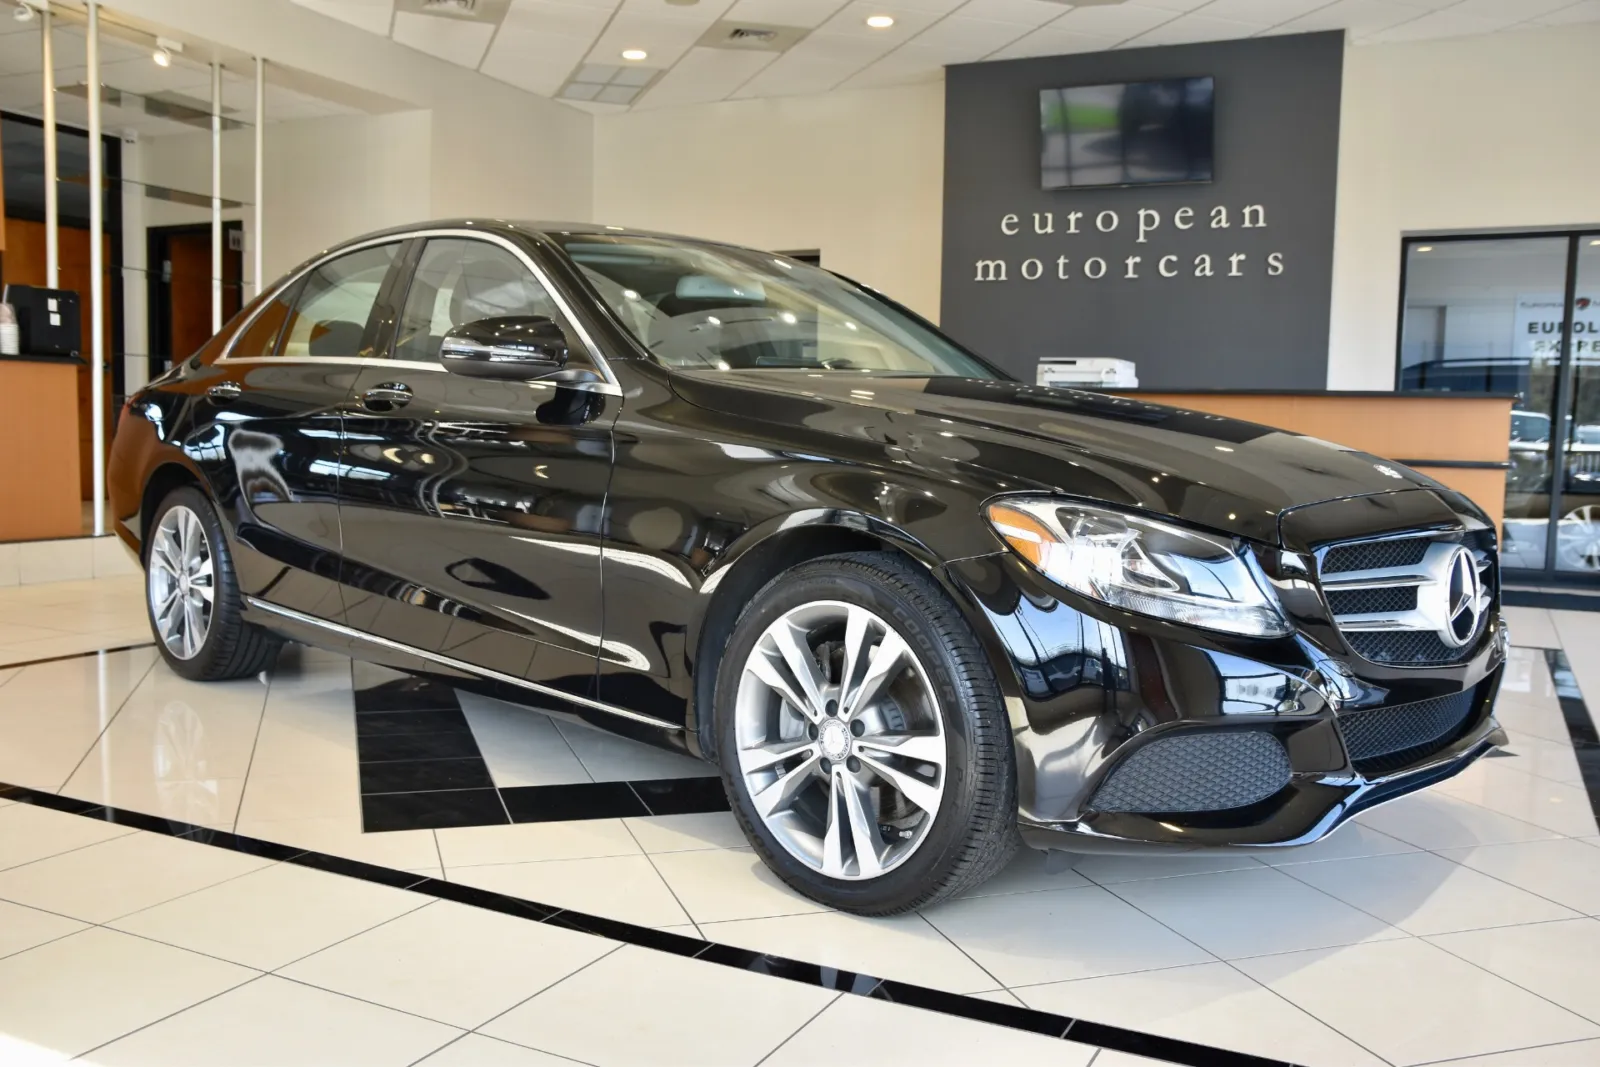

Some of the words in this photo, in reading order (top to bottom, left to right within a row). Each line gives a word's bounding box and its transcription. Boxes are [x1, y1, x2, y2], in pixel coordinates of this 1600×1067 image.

[1000, 202, 1267, 244] european
[974, 251, 1285, 282] motorcars
[892, 607, 956, 703] COOPER
